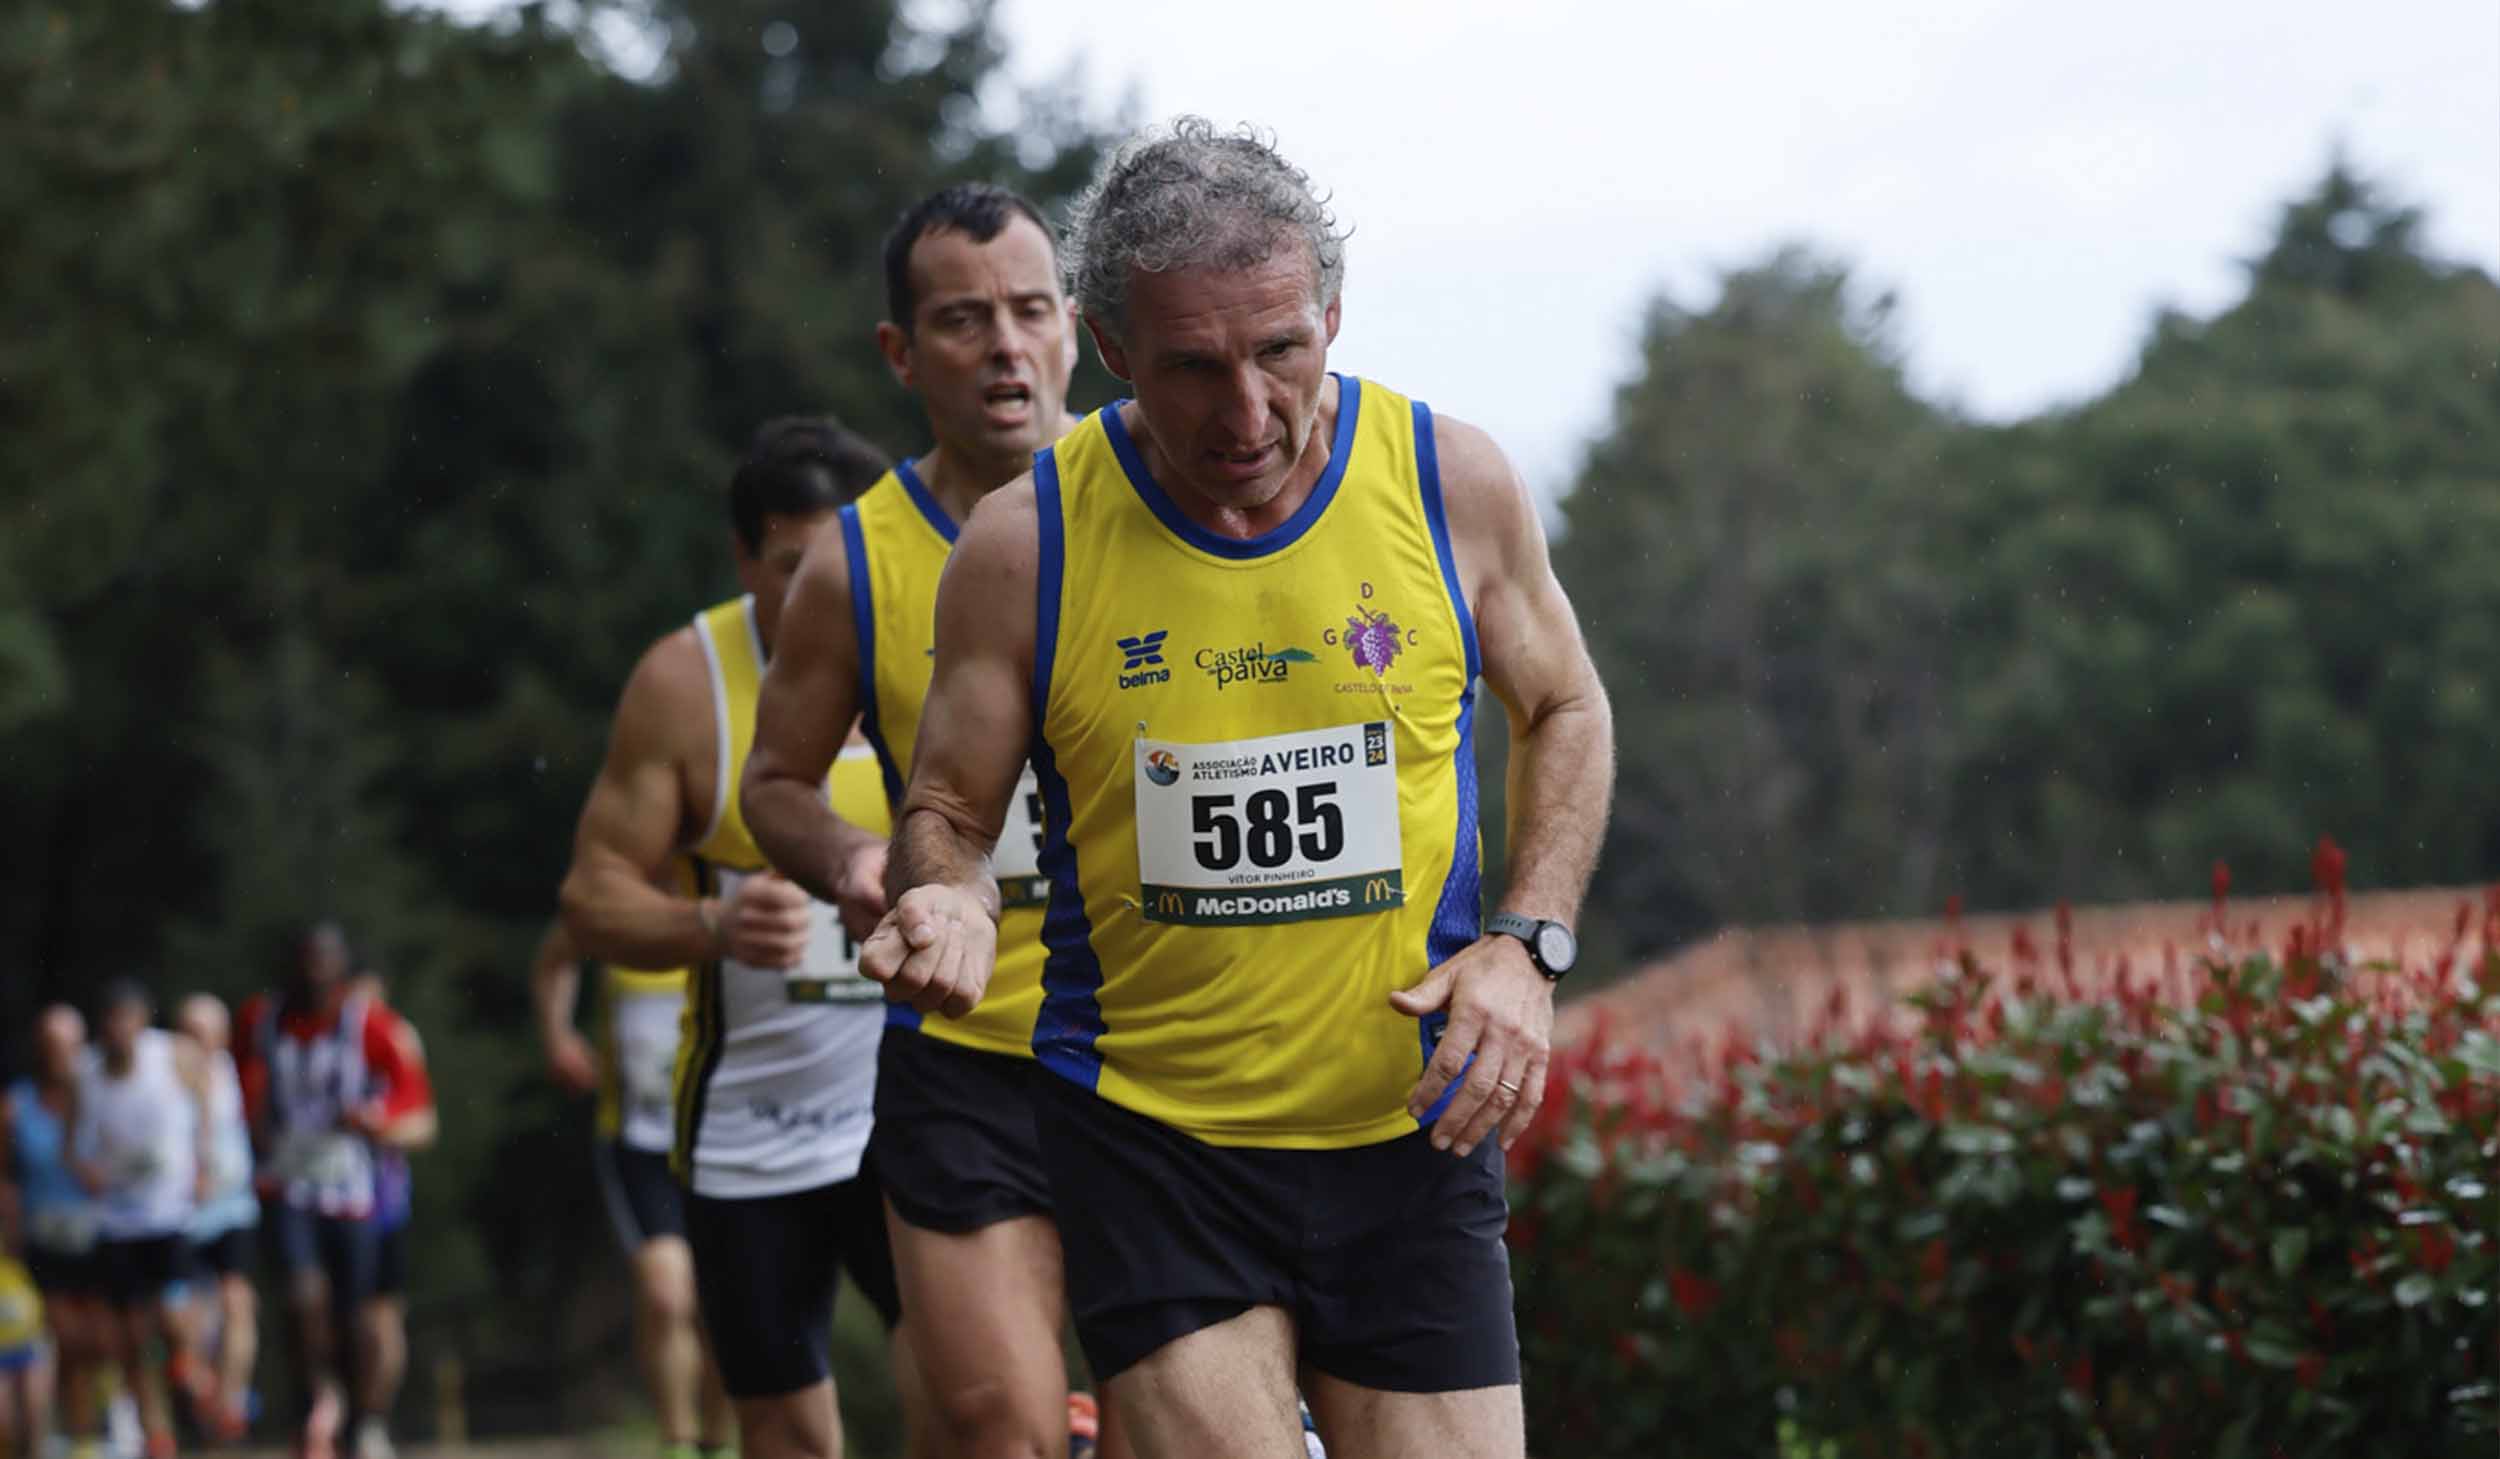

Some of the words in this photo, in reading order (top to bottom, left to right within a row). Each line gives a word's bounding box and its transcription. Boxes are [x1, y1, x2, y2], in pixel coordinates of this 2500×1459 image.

[1361, 582, 1373, 599] D
[1323, 628, 1337, 646] G
[1407, 629, 1418, 646] C
[1194, 641, 1264, 669] Castel
[1217, 659, 1288, 691] paiva
[1368, 735, 1384, 749] 23
[1260, 743, 1355, 776] AVEIRO
[1368, 748, 1385, 764] 24
[1192, 767, 1259, 781] ATLETISMO
[1191, 781, 1345, 871] 585
[1263, 868, 1316, 883] PINHEIRO
[1195, 888, 1351, 916] McDonald's
